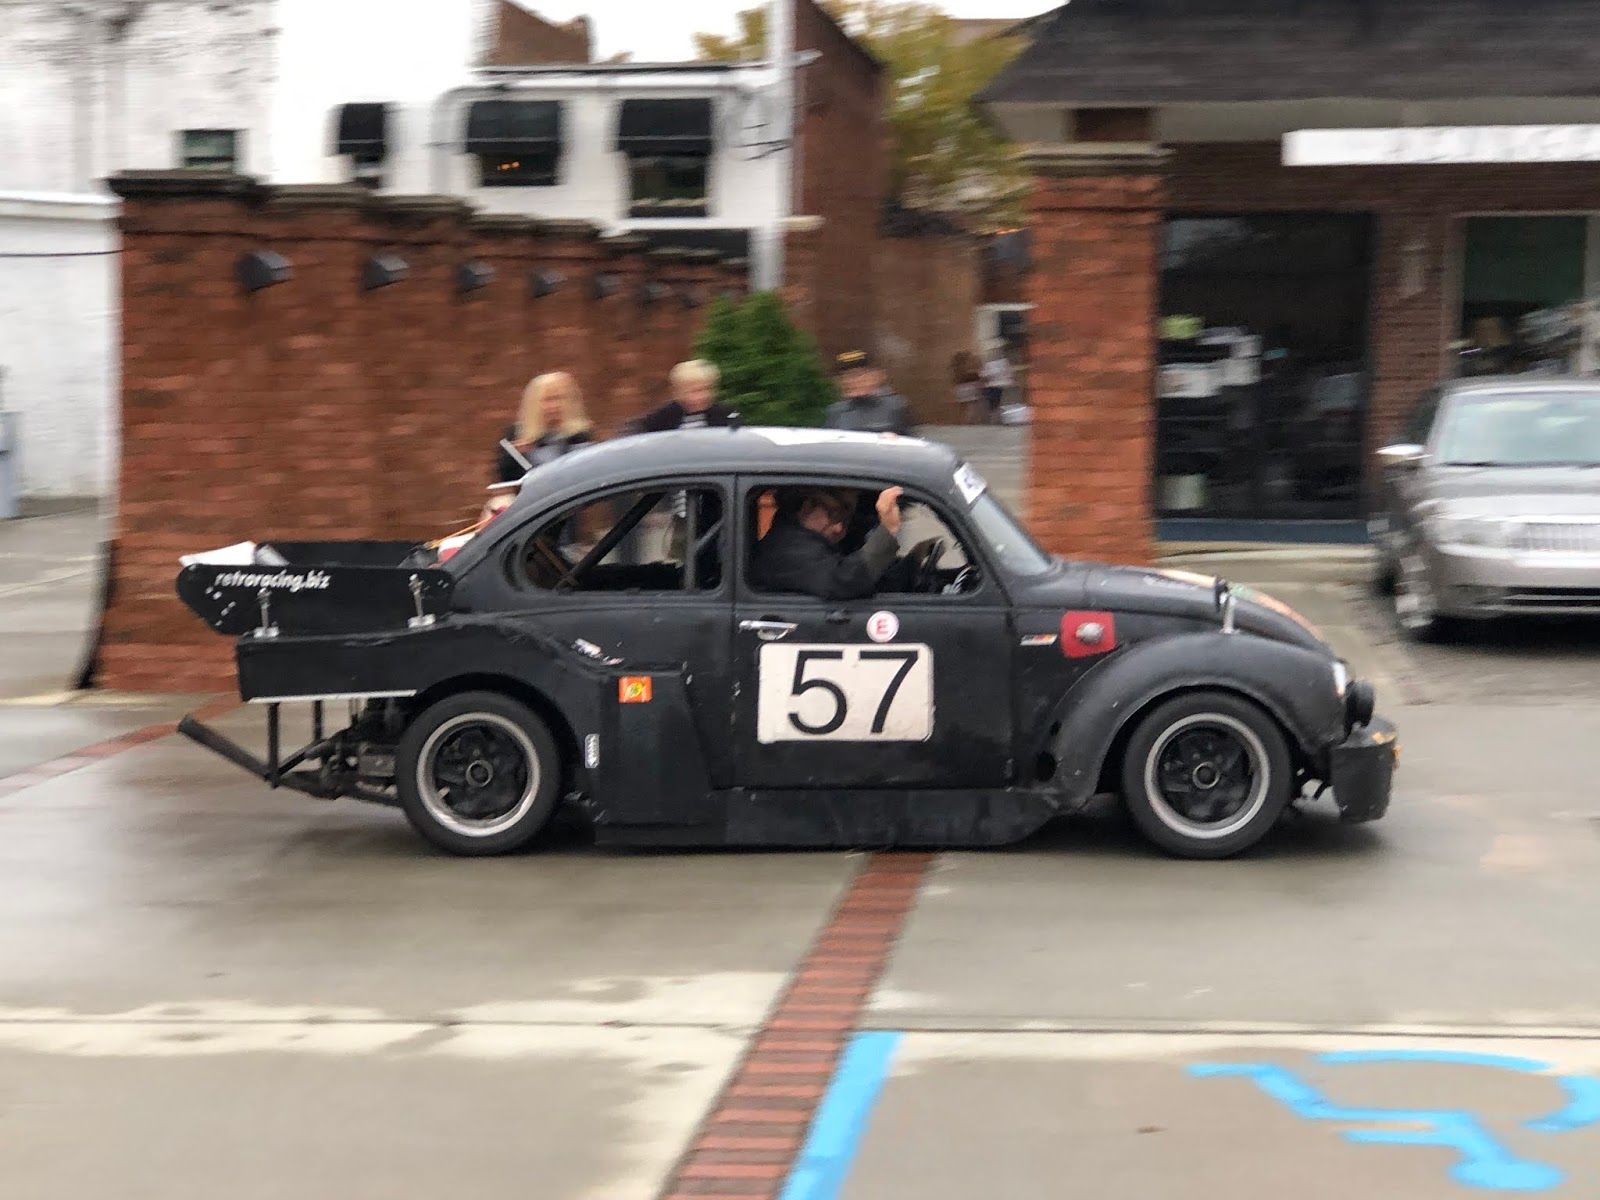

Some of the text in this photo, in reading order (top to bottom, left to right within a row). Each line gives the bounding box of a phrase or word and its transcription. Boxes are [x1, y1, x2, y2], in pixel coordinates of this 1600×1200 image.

[215, 569, 331, 592] retroracing.biz
[876, 619, 889, 635] E
[788, 650, 919, 734] 57
